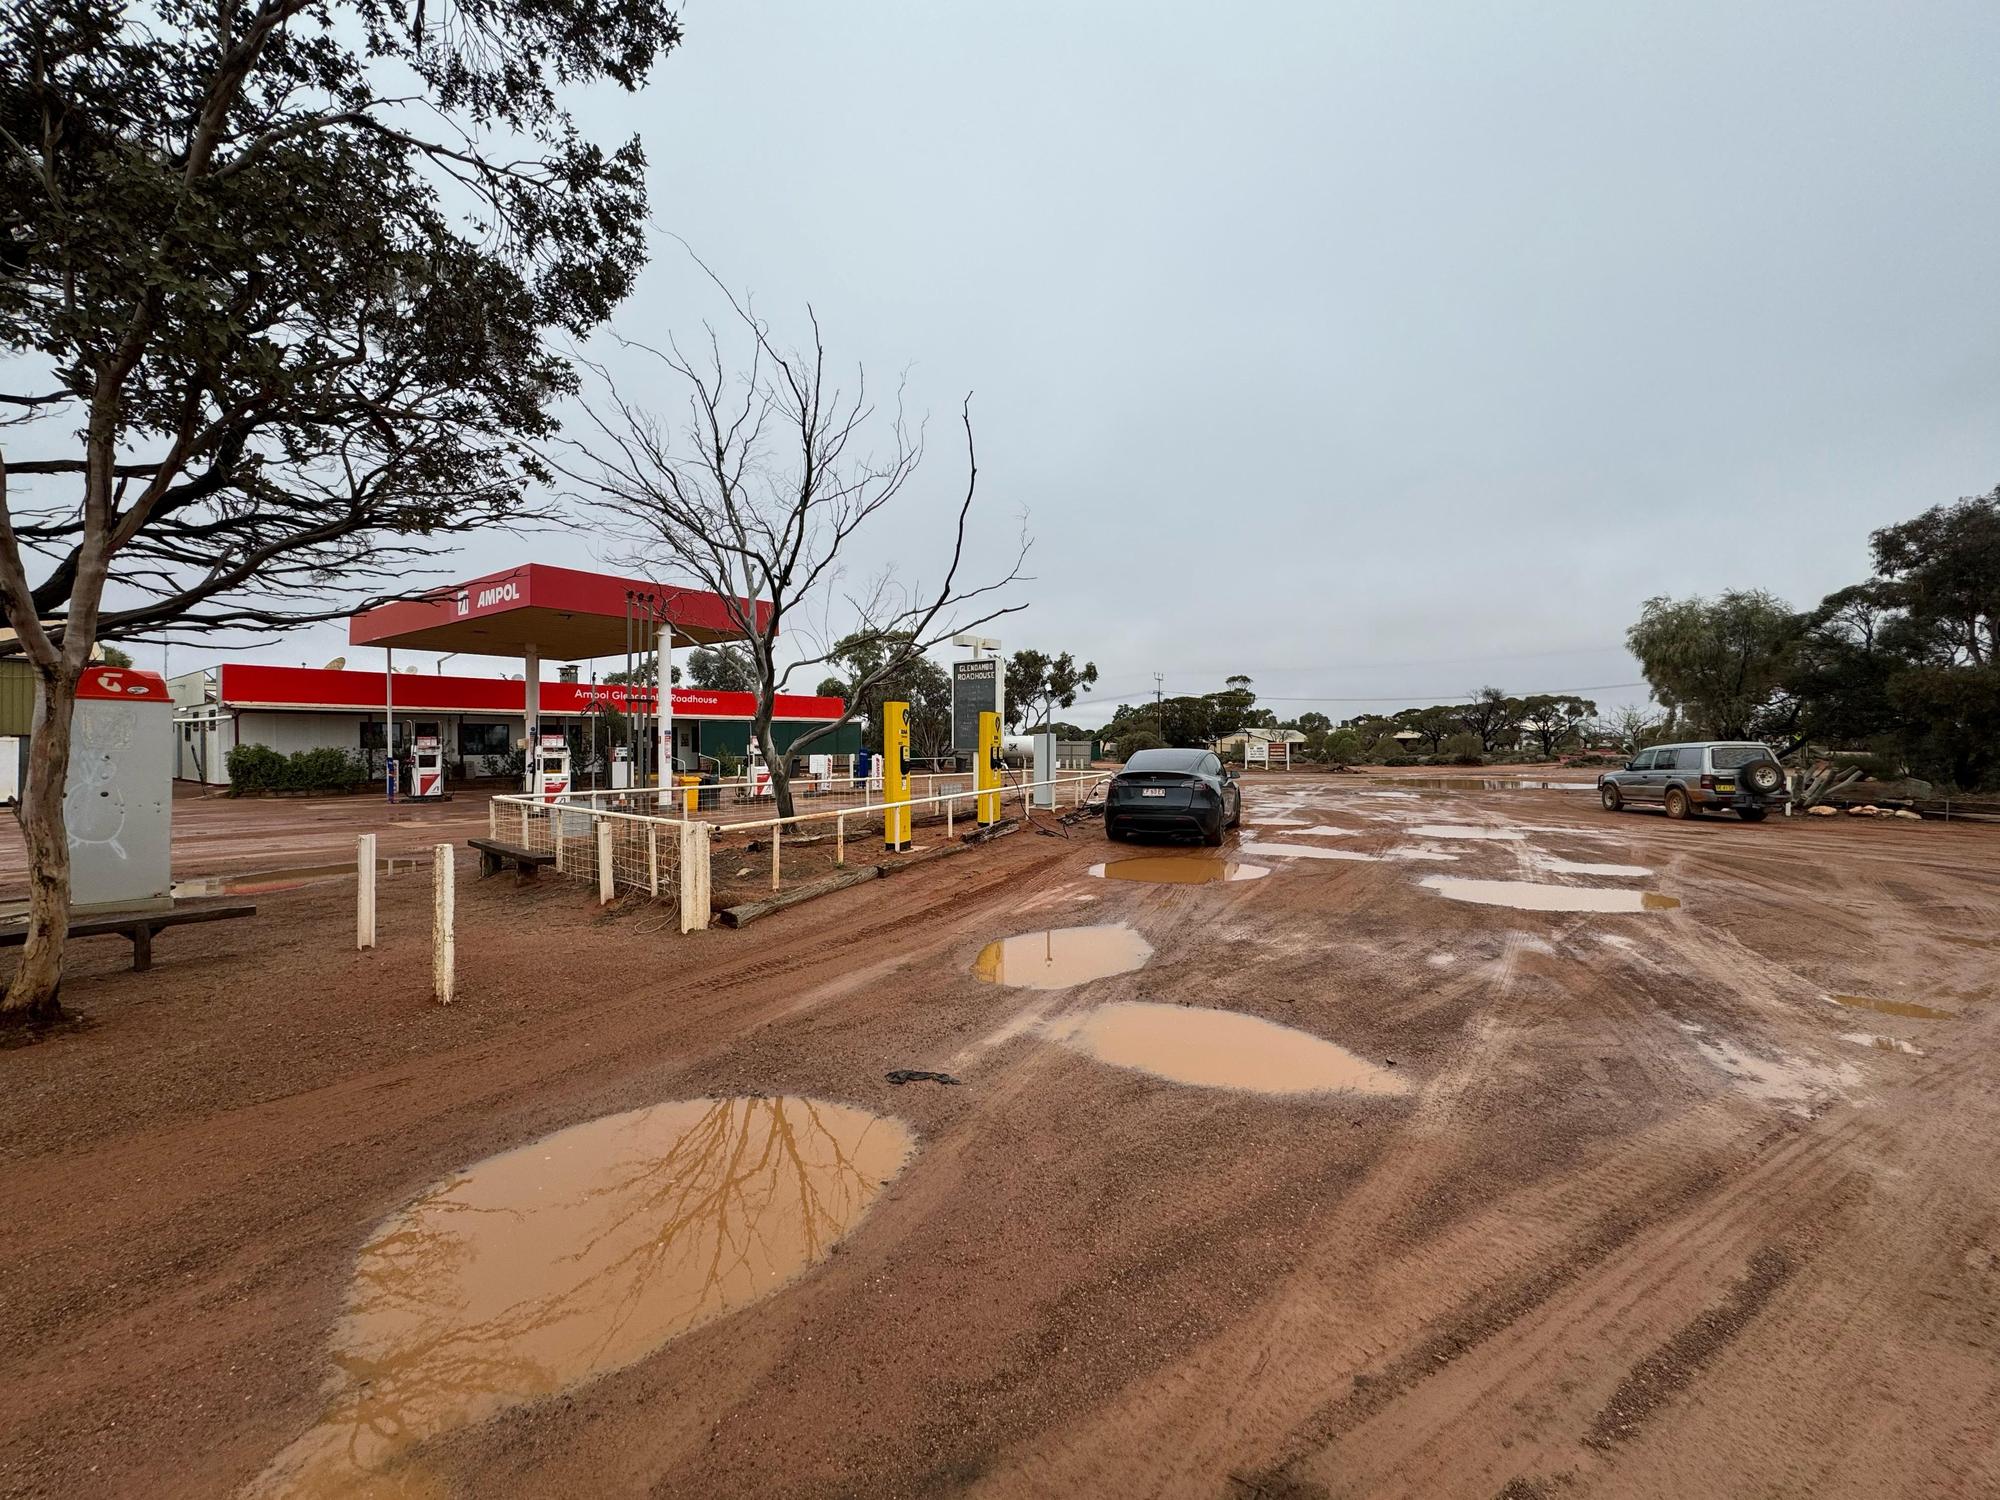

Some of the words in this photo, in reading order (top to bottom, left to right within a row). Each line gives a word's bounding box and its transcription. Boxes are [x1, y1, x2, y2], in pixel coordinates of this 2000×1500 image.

[477, 583, 519, 608] AMPOL
[957, 671, 995, 680] ROADHOUSE
[671, 693, 718, 704] Roadhouse
